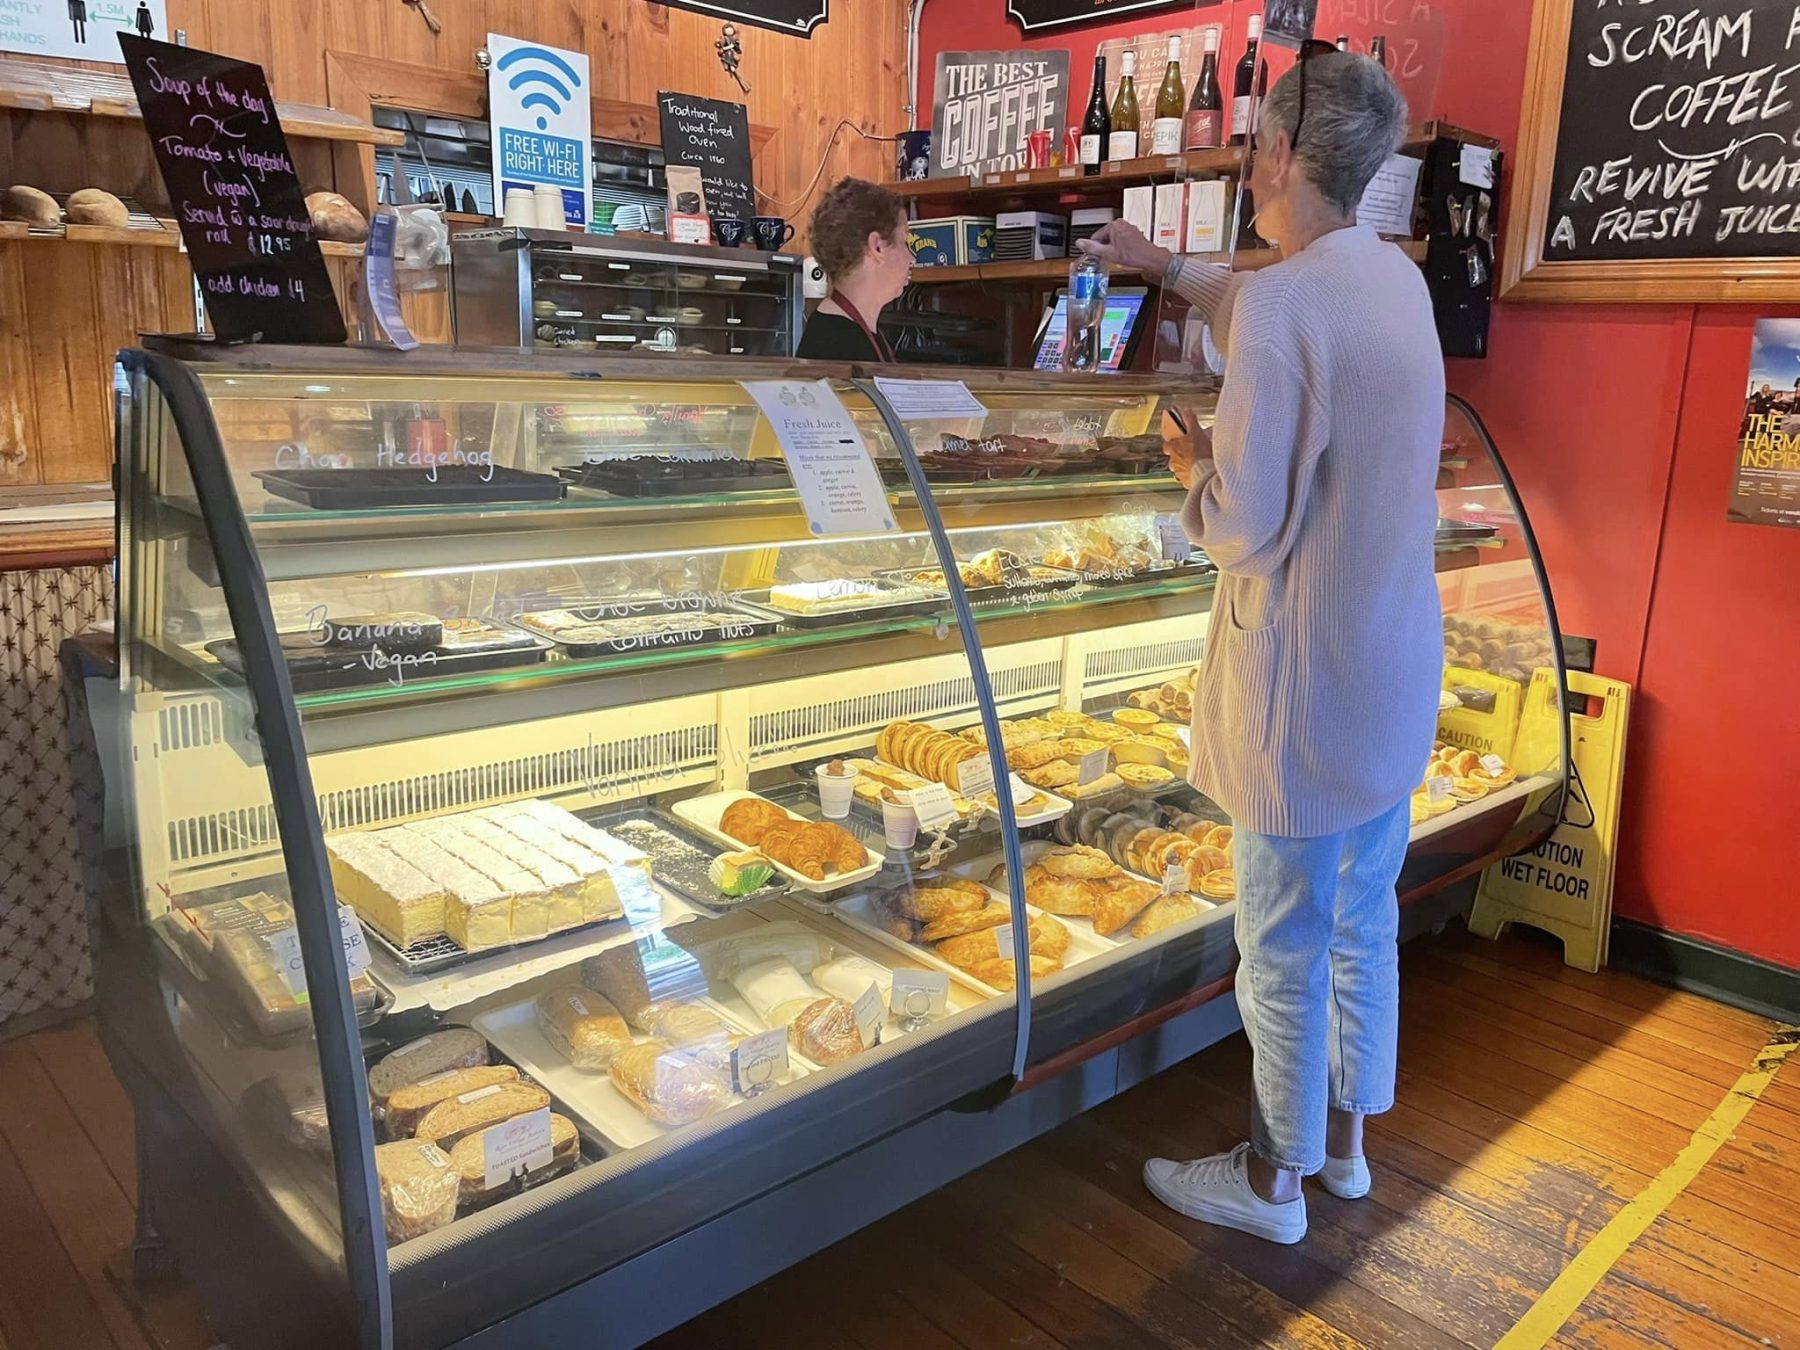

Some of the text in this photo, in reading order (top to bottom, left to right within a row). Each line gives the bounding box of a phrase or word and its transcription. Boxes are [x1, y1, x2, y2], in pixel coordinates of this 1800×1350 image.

[1587, 8, 1753, 70] SCREAM
[146, 57, 269, 124] Soup of the day
[945, 61, 1049, 98] THE BEST
[662, 97, 719, 123] Traditional
[1629, 63, 1800, 131] COFFEE
[678, 121, 734, 139] Wood fired
[940, 73, 1059, 169] COFFEE
[505, 133, 576, 160] FREE WI-FI
[688, 134, 718, 149] Oven
[159, 135, 222, 163] Tomato
[238, 145, 294, 182] Vegetable
[505, 151, 543, 172] RIGHT
[547, 157, 580, 178] HERE
[203, 170, 260, 207] (vegan)
[1570, 155, 1719, 203] REVIVE
[183, 200, 228, 227] Served
[1550, 215, 1576, 250] A
[1590, 198, 1701, 245] FRESH
[206, 228, 232, 245] roll
[208, 275, 234, 293] add
[784, 419, 842, 430] Fresh Juice
[1748, 413, 1785, 434] THE
[978, 437, 1007, 453] tart
[1743, 431, 1800, 451] HARM
[376, 439, 495, 483] Hedgehog
[305, 604, 423, 645] Banana
[719, 618, 755, 640] nuts
[1438, 727, 1493, 751] CAUTION
[1527, 839, 1583, 868] UTION
[1501, 858, 1589, 900] WET FLOOR
